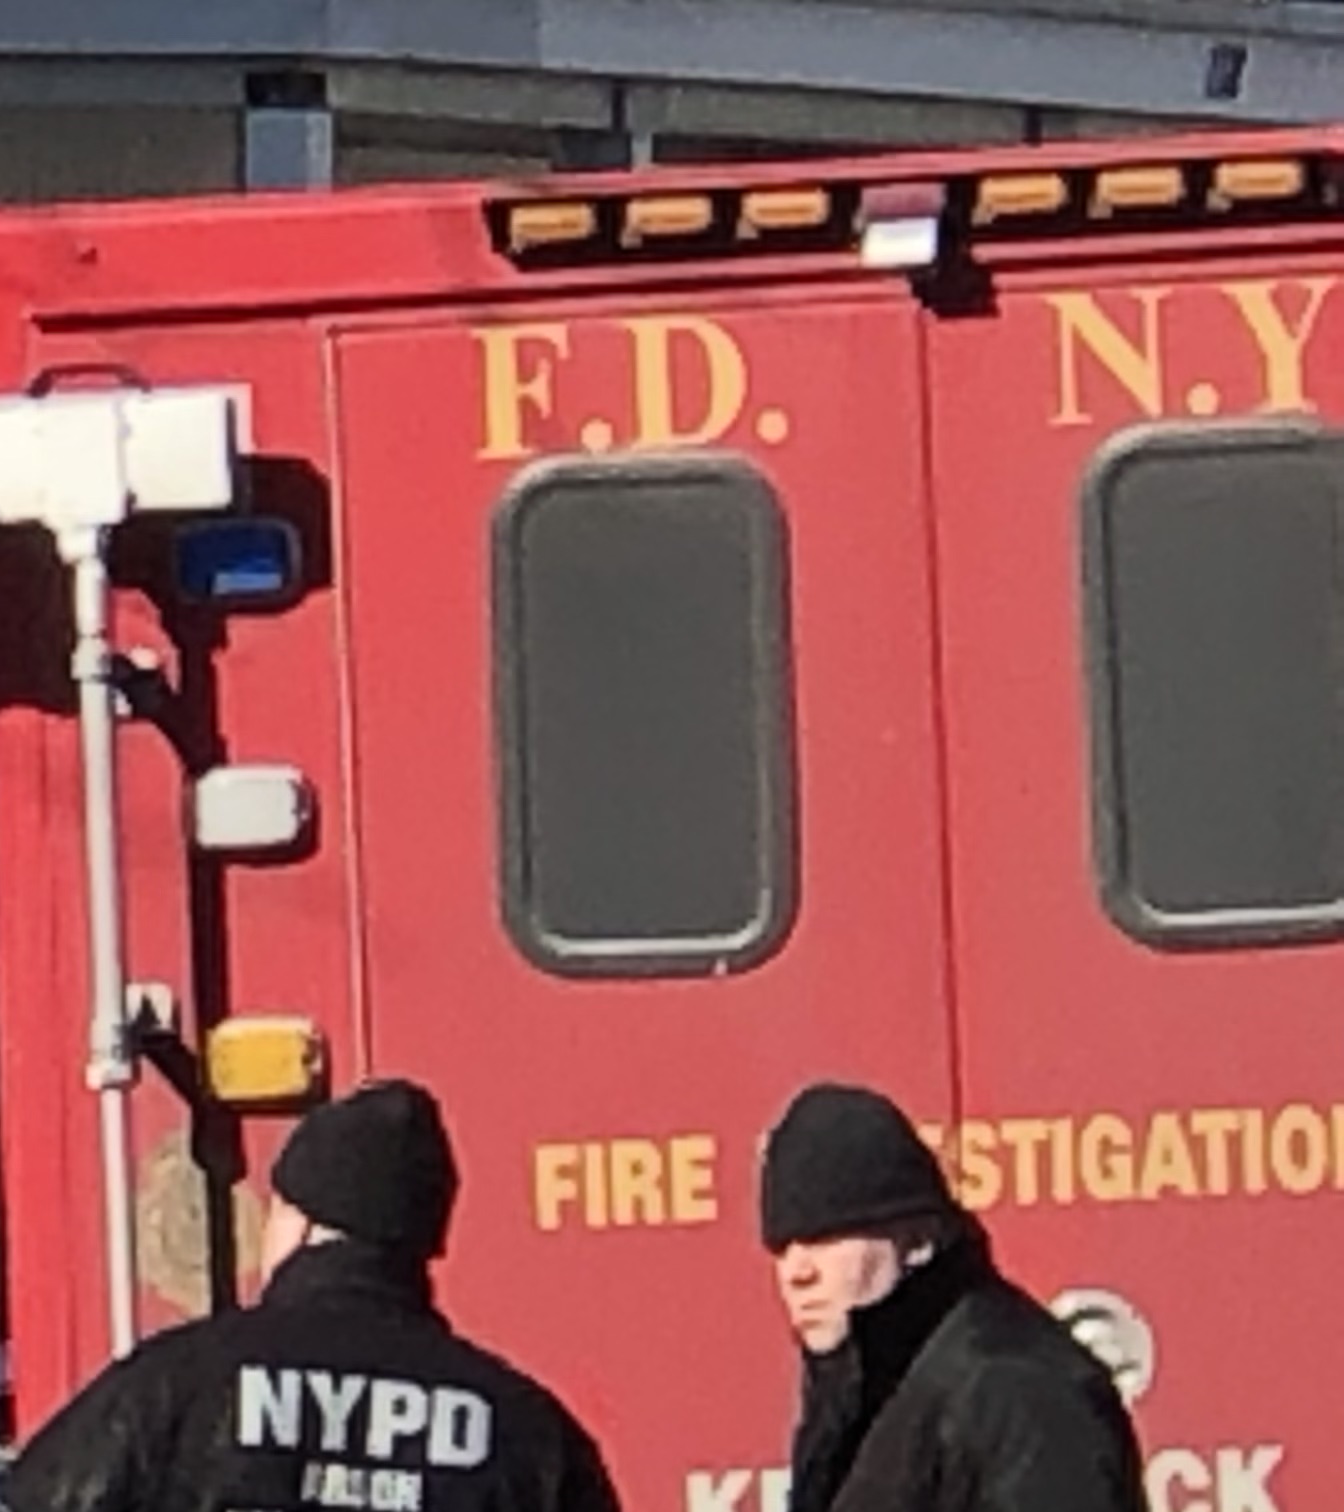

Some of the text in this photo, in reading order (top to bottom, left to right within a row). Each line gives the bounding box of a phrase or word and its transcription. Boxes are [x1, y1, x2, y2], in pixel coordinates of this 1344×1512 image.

[470, 314, 789, 460] F.D.
[535, 1104, 1344, 1231] FIRE STIGATIO
[238, 1364, 492, 1468] NYPD
